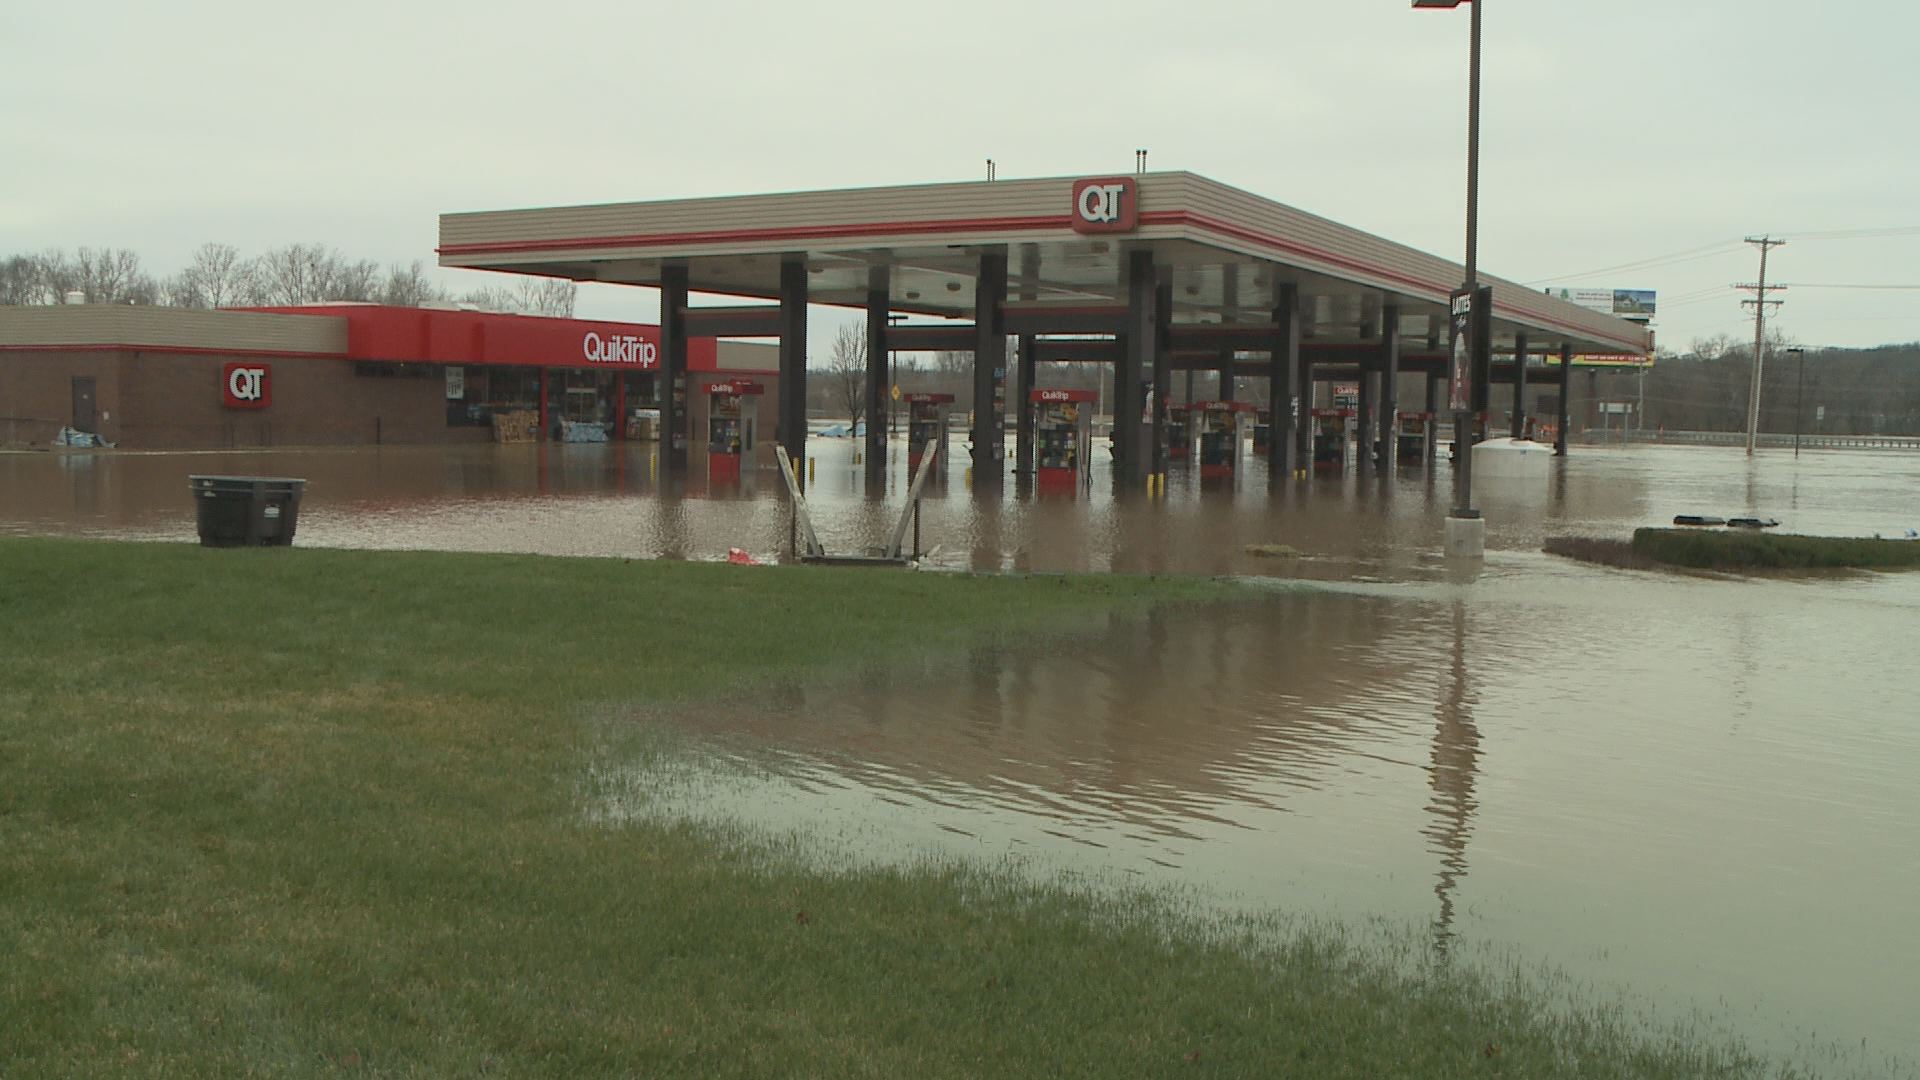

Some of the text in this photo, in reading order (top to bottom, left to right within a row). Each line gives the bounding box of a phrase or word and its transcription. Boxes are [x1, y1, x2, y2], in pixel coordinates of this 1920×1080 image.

[1079, 185, 1123, 223] QT
[583, 332, 656, 368] QuikTrip
[229, 367, 264, 400] QT
